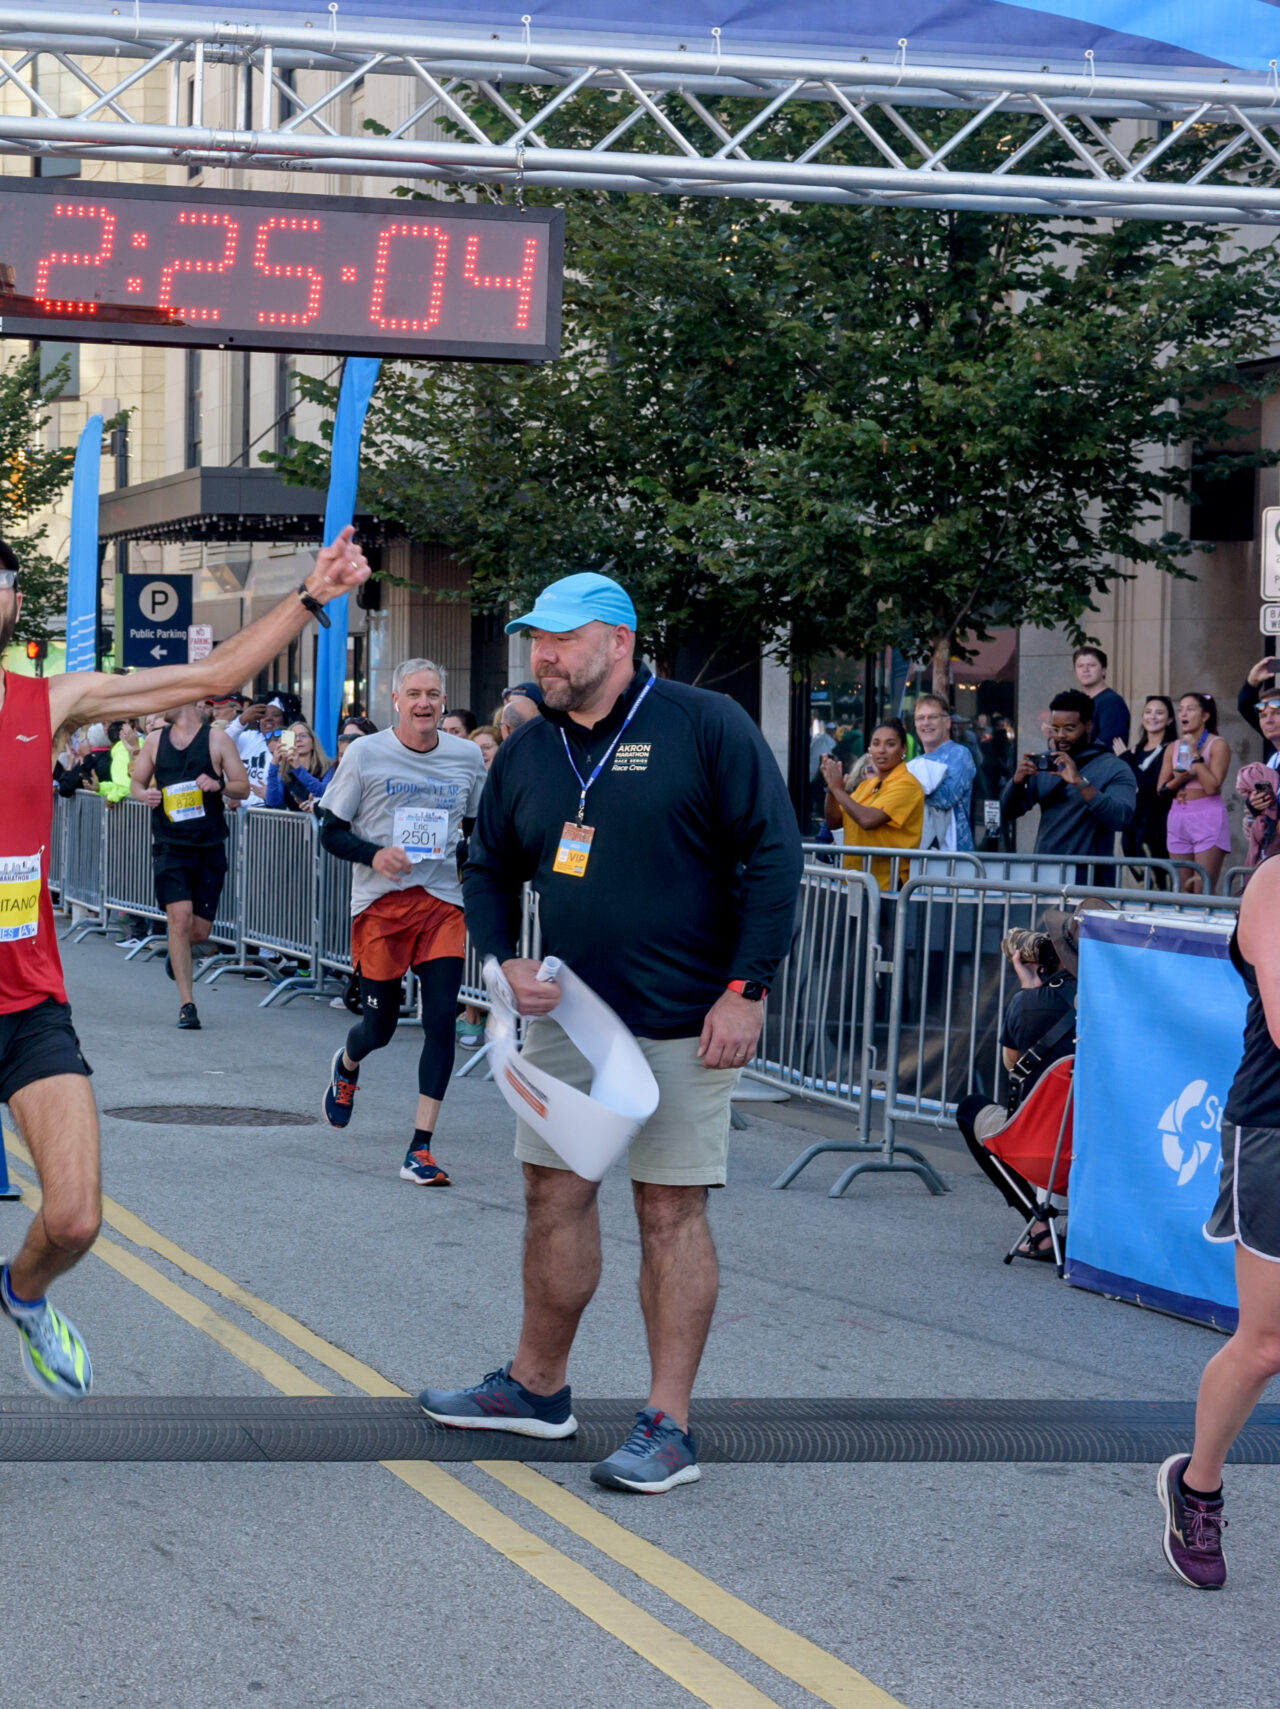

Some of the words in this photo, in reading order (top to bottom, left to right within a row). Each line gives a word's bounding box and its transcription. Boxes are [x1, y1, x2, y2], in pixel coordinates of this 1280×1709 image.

[151, 590, 169, 615] P
[130, 628, 155, 639] Public
[156, 628, 187, 640] Parking
[617, 744, 651, 752] AKRON
[175, 797, 196, 809] 873
[413, 822, 429, 831] Eric
[401, 829, 438, 847] 2501
[569, 852, 586, 864] VIP
